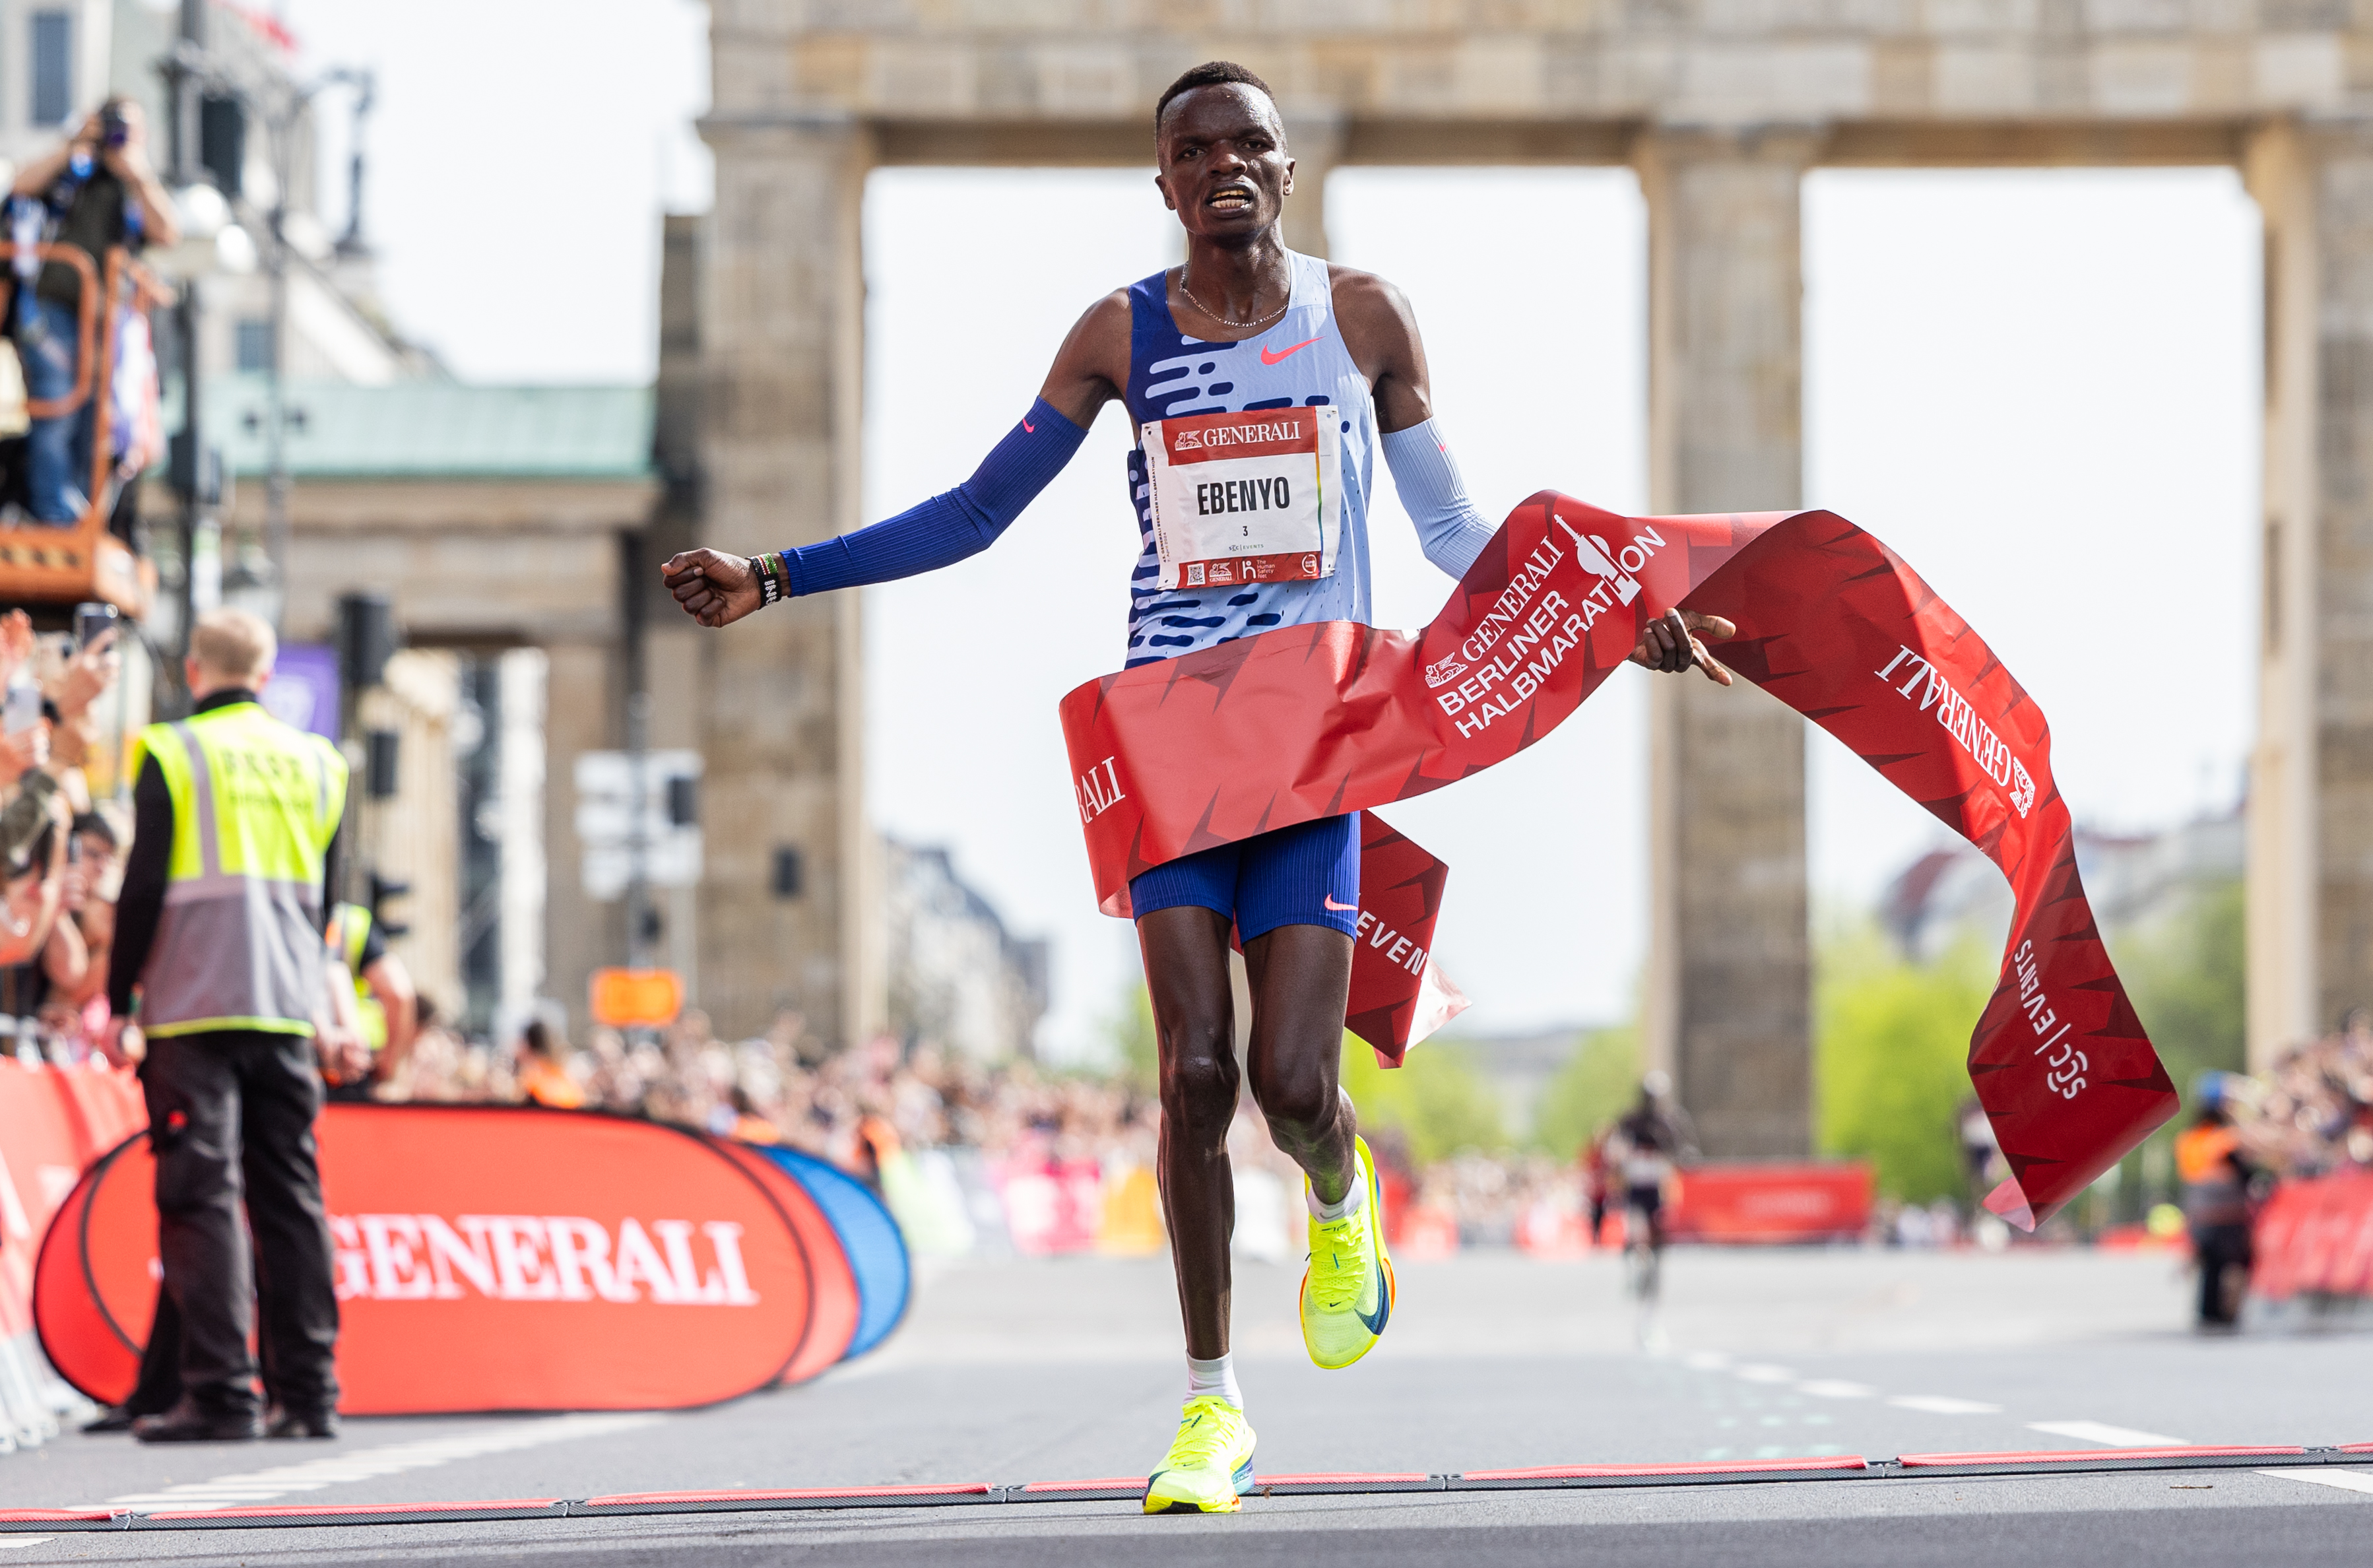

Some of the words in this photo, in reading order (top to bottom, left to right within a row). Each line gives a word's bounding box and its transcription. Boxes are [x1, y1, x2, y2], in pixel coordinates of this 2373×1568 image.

[1203, 421, 1301, 447] GENERALI
[1197, 476, 1290, 515] EBENYO
[1243, 525, 1248, 537] 3
[1454, 525, 1667, 739] HALBMARATHON
[1462, 535, 1565, 661] GENERALI
[1437, 590, 1569, 717] BERLINER
[1874, 644, 2011, 787] GENERALI
[2014, 939, 2057, 1036] EVENTS
[2047, 1043, 2089, 1099] SCC
